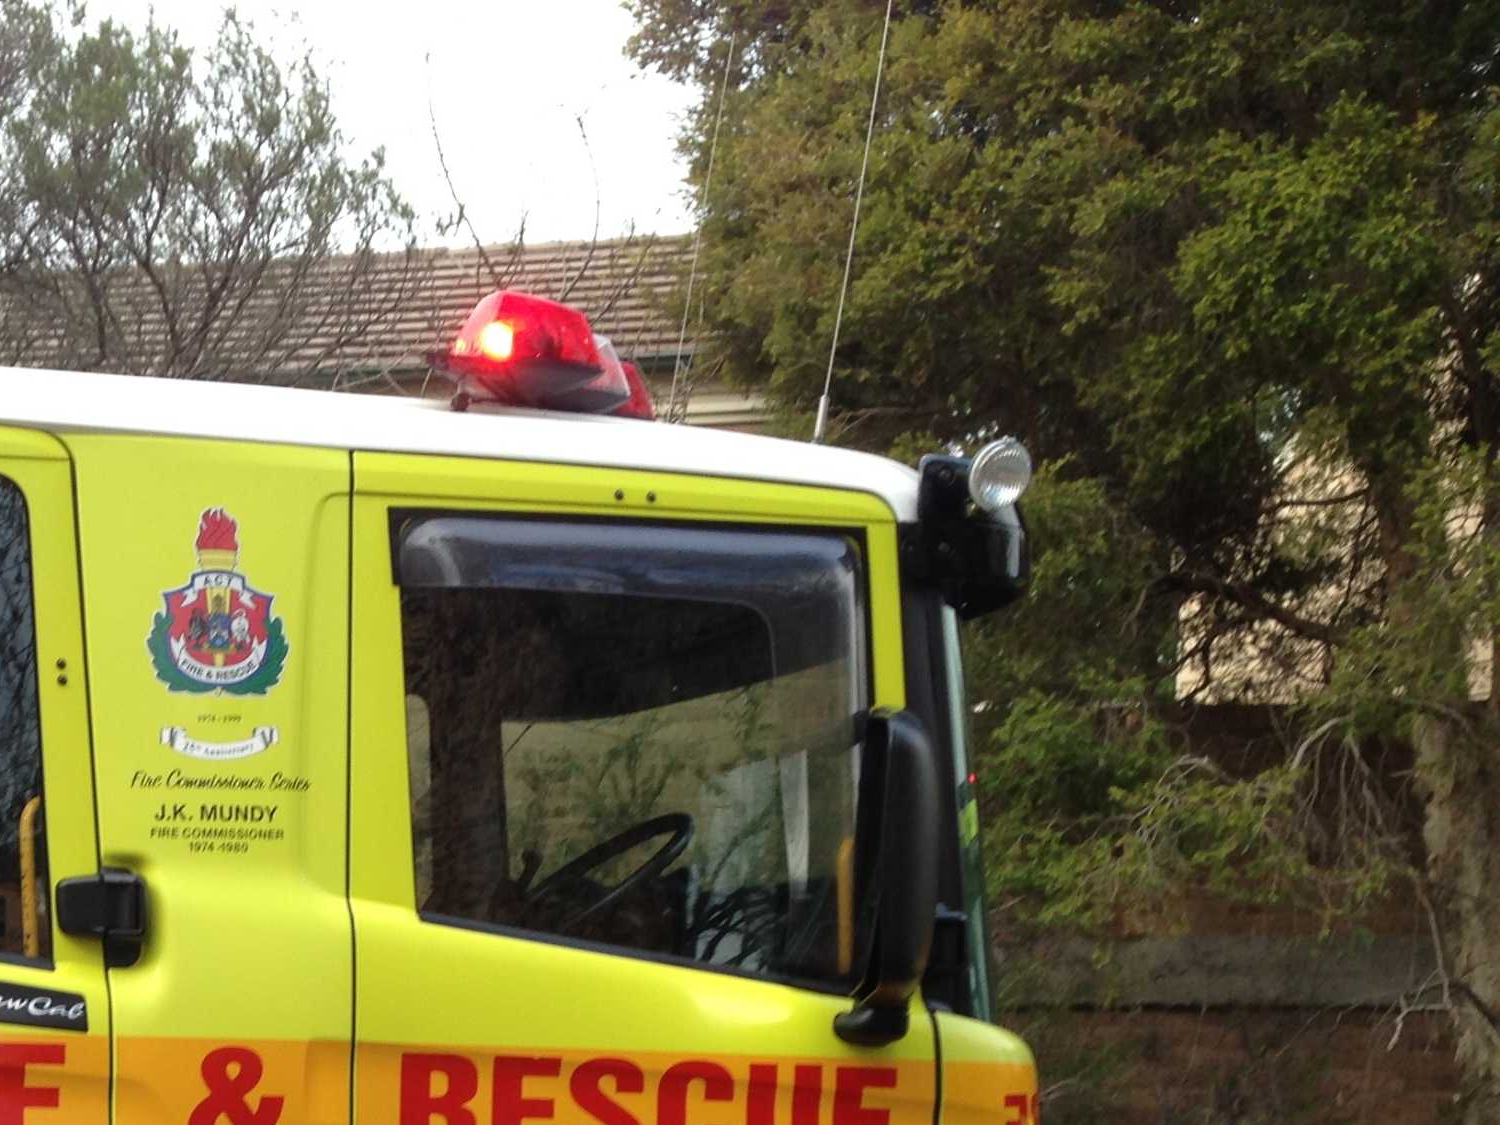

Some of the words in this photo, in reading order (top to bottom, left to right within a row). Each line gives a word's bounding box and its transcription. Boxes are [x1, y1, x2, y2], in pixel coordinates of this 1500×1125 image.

[180, 659, 204, 676] FIRE
[215, 660, 257, 680] RESCUE
[130, 770, 162, 789] Fire
[166, 768, 264, 790] Commissioner
[268, 771, 311, 792] Series
[200, 804, 278, 823] MUNDY
[149, 827, 179, 839] FIRE
[182, 827, 285, 841] COMMISSIONER
